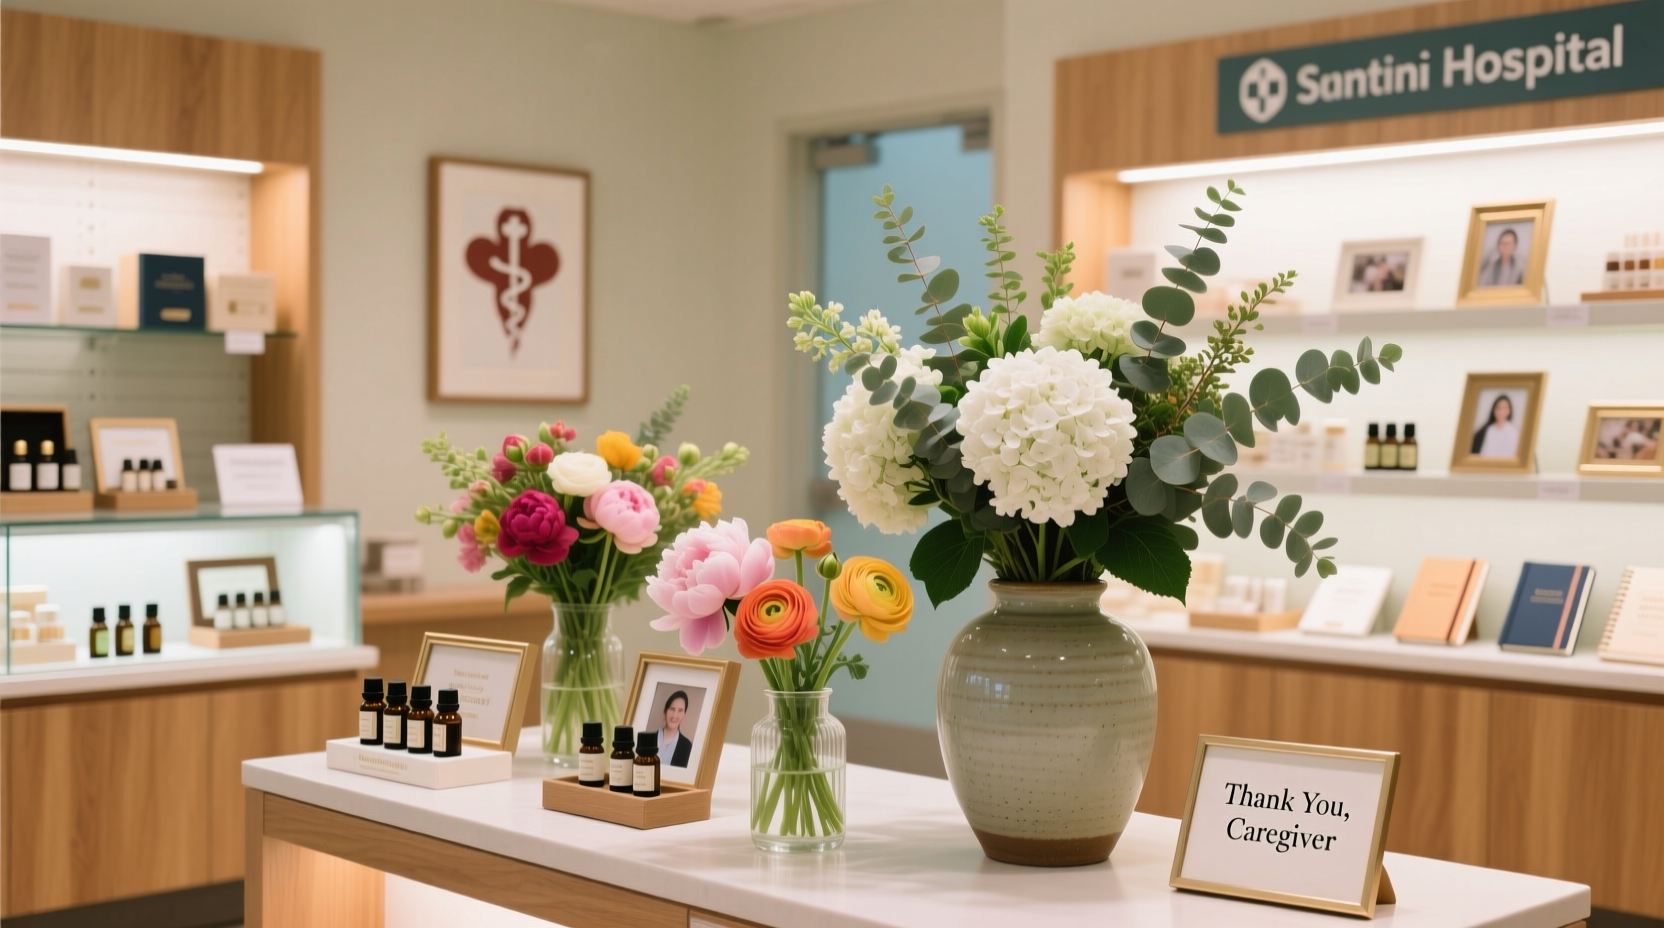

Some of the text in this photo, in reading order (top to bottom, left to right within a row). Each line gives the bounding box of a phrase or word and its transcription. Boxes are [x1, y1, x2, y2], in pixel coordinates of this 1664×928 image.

[1296, 23, 1624, 105] Santini Hospital
[1225, 782, 1350, 822] Thank You,
[1226, 817, 1337, 853] Caregiver
